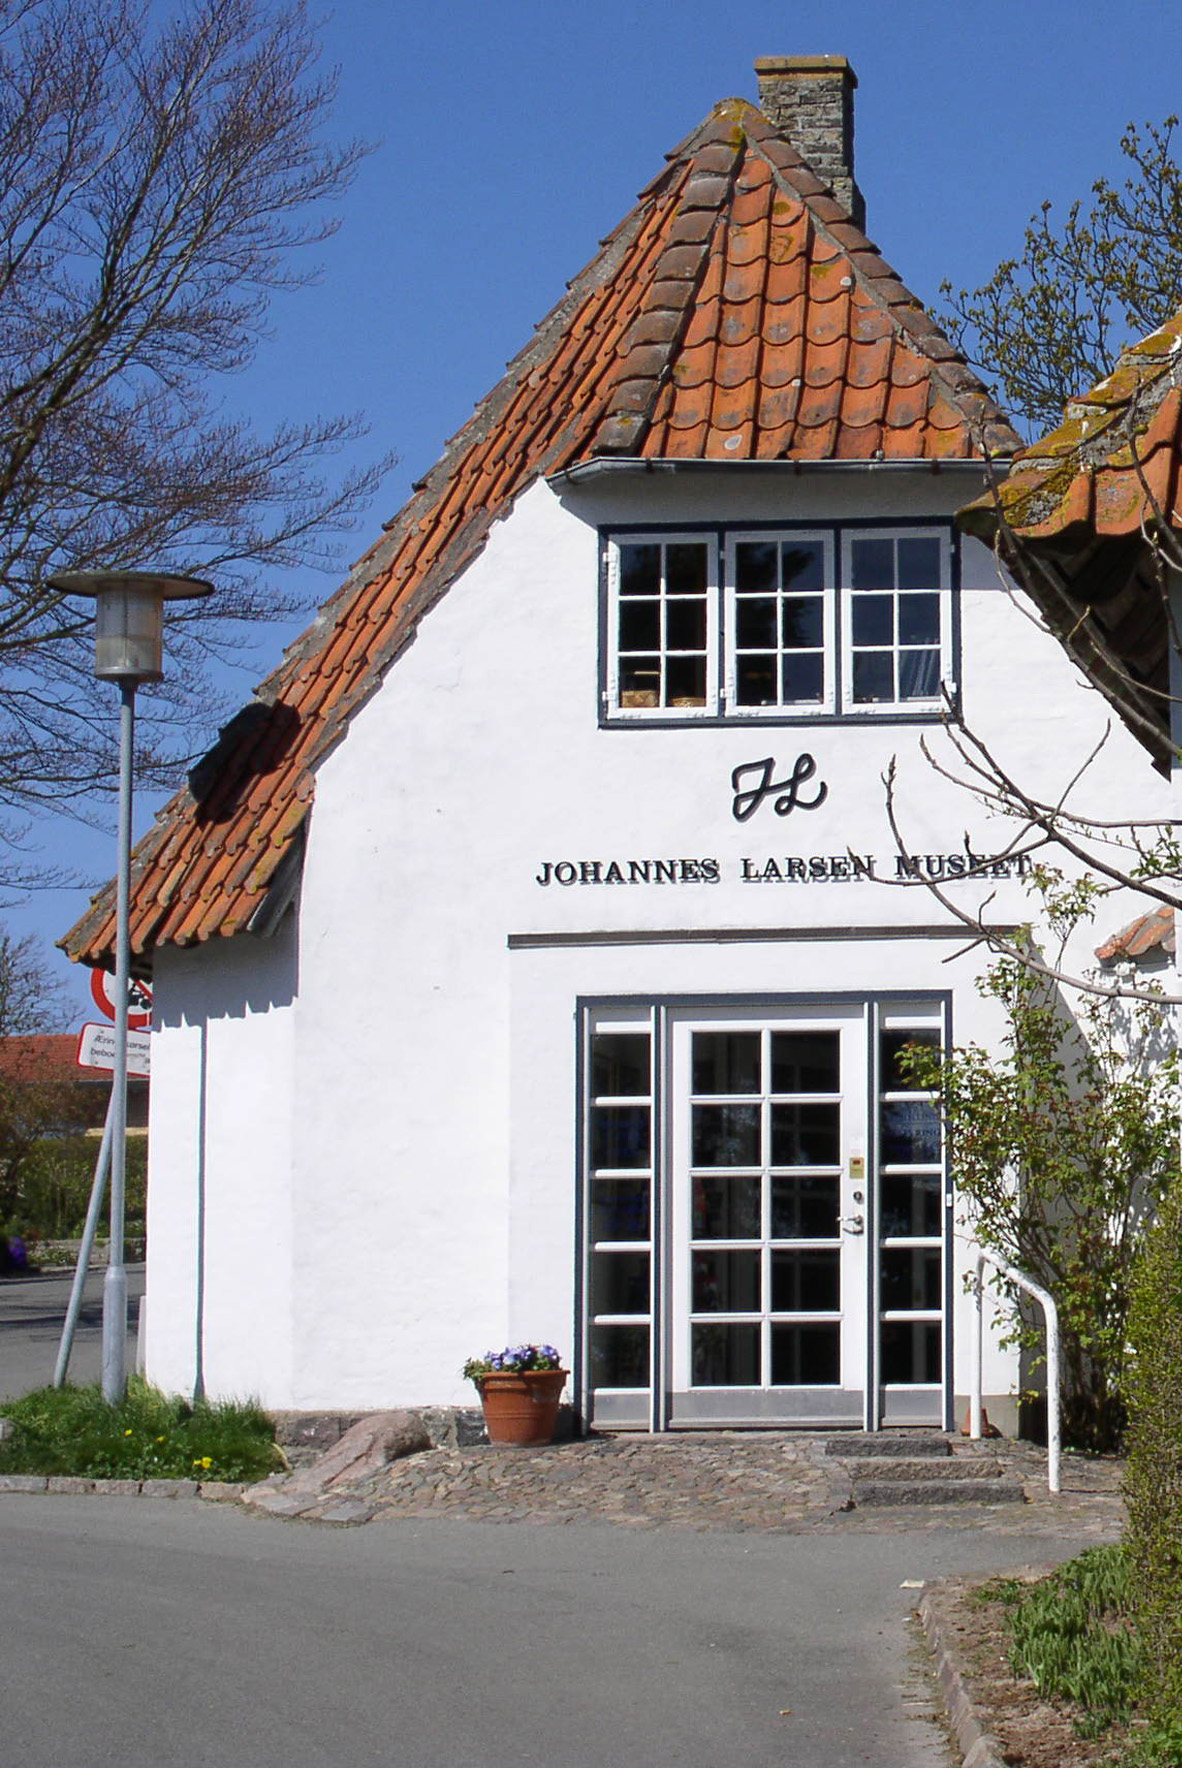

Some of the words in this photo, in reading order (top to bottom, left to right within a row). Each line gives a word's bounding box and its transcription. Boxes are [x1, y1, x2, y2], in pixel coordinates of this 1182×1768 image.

[536, 858, 720, 886] JOHANNES
[740, 855, 876, 884] LARSEN
[894, 854, 1033, 880] MUSEET
